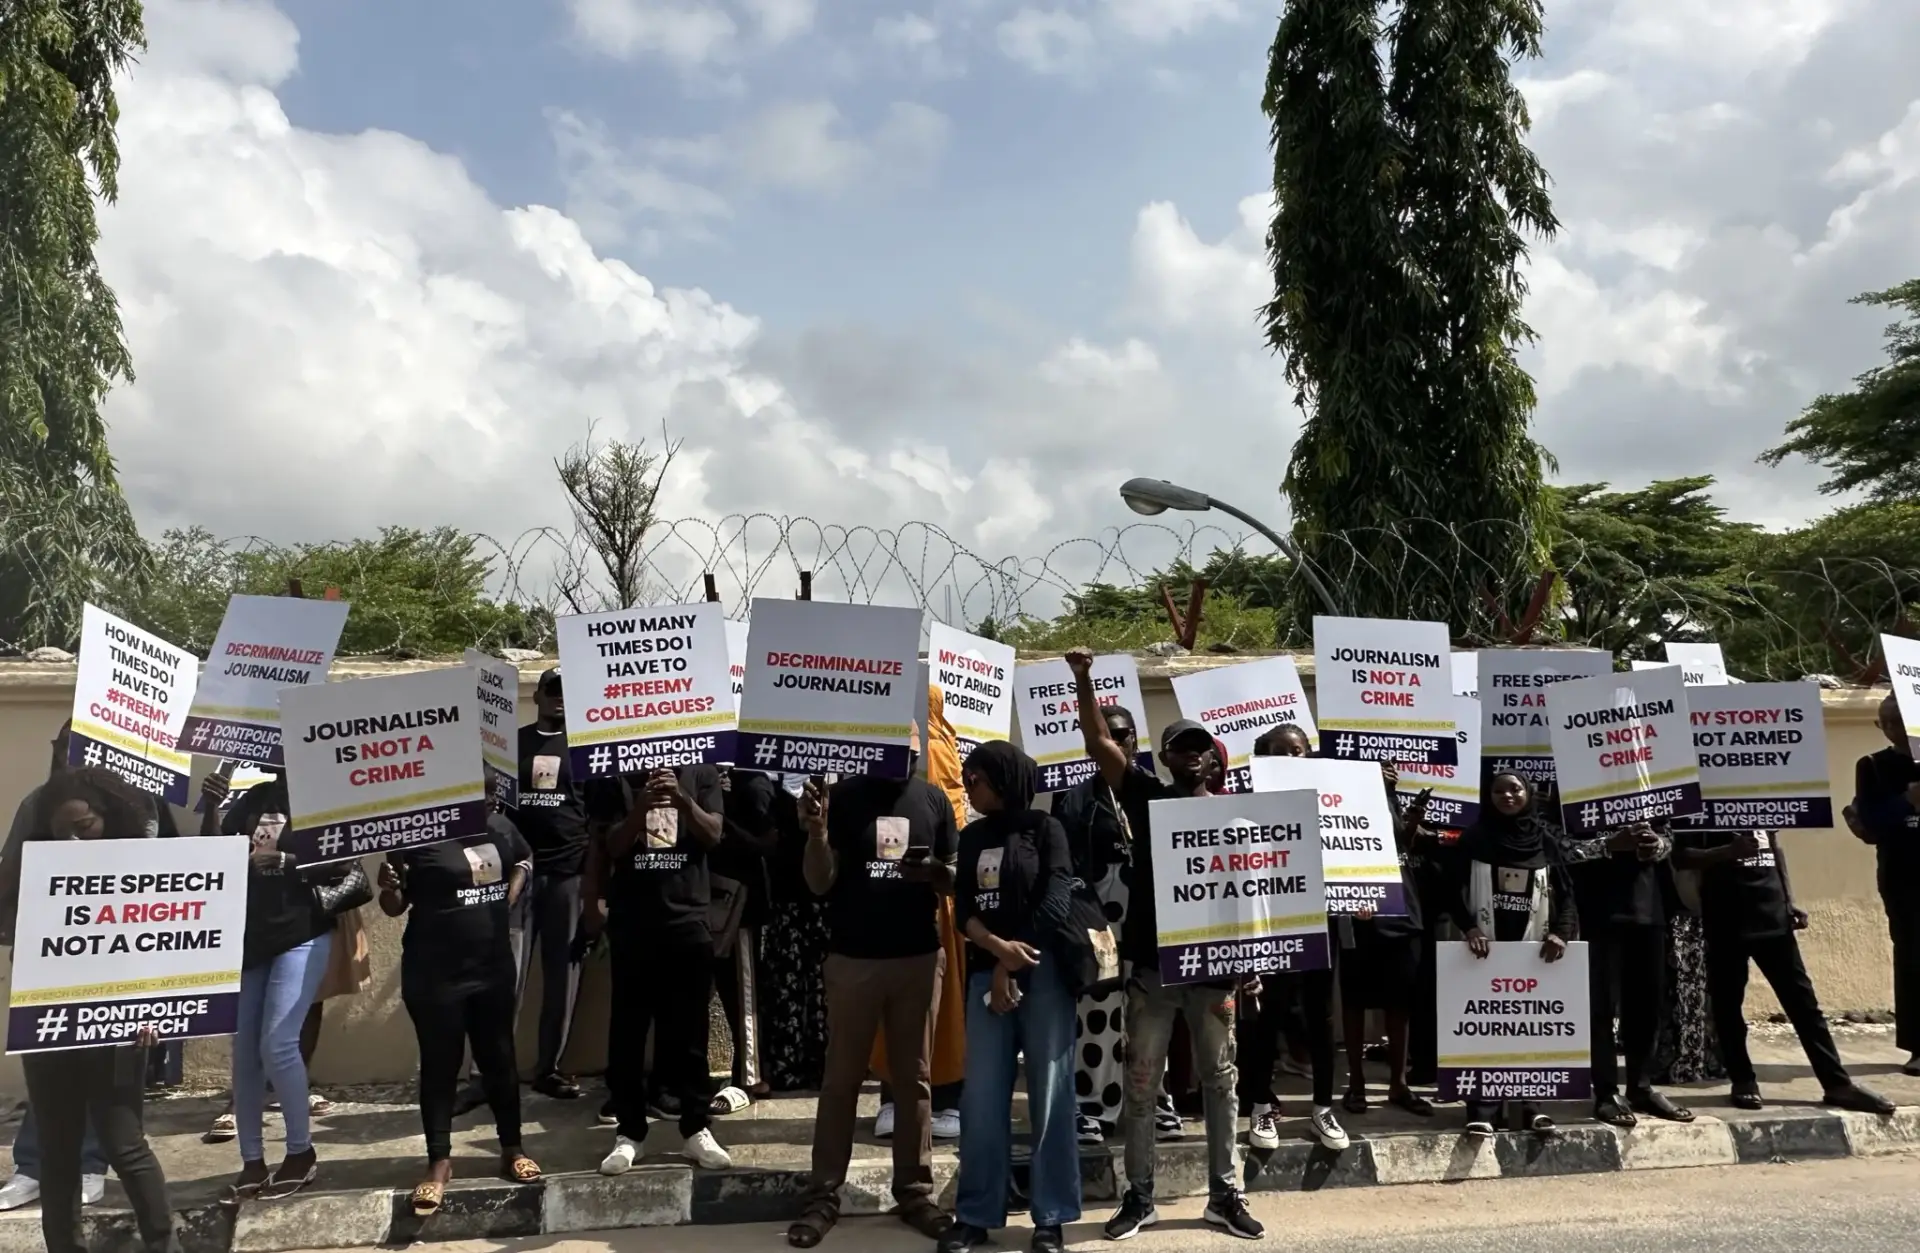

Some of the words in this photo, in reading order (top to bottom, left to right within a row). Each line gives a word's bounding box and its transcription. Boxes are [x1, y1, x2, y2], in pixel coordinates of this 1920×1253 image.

[588, 619, 636, 637] HOW
[640, 614, 697, 633] MANY
[105, 623, 140, 648] HOW
[142, 640, 181, 669] MANY
[225, 642, 325, 665] DECRIMINALIZE
[597, 638, 653, 657] TIMES
[656, 637, 684, 652] DO
[687, 636, 692, 649] I
[110, 645, 147, 674] TIMES
[151, 666, 169, 684] DO
[170, 674, 174, 687] I
[607, 661, 659, 678] HAVE
[661, 657, 687, 674] TO
[766, 651, 903, 676] DECRIMINALIZE
[939, 649, 956, 665] MY
[958, 656, 993, 677] STORY
[994, 666, 1004, 681] IS
[1331, 648, 1440, 668] JOURNALISM
[224, 662, 311, 684] JOURNALISM
[939, 669, 963, 688] NOT
[964, 677, 1001, 698] ARMED
[1352, 669, 1367, 683] IS
[1370, 671, 1406, 686] NOT
[1408, 673, 1421, 687] A
[1493, 675, 1530, 688] FREE
[1684, 673, 1704, 684] ANY
[113, 669, 148, 695] HAVE
[151, 686, 168, 704] TO
[604, 678, 693, 700] #FREEMY
[773, 674, 891, 696] JOURNALISM
[1029, 683, 1066, 699] FREE
[1068, 676, 1125, 694] SECH
[107, 688, 170, 726] #FREEMY
[477, 686, 514, 714] DNAPPERS
[586, 696, 715, 723] COLLEAGUES?
[945, 691, 994, 716] ROBBERY
[1042, 703, 1057, 716] IS
[1060, 701, 1072, 714] A
[1200, 693, 1298, 722] DECRIMINALIZE
[1361, 690, 1415, 707] CRIME
[1504, 694, 1518, 706] IS
[1521, 694, 1533, 706] A
[303, 706, 460, 743] JOURNALISM
[1213, 709, 1296, 736] JOURNALISM
[1492, 713, 1527, 726] NOT
[1529, 713, 1543, 726] A
[1564, 699, 1674, 730] JOURNALISM
[1716, 709, 1781, 724] STORY
[1785, 708, 1804, 723] IS
[1035, 720, 1068, 737] NOT
[1588, 733, 1604, 748] IS
[1606, 728, 1642, 745] NOT
[1644, 724, 1658, 739] A
[1730, 729, 1803, 746] ARMED
[208, 738, 272, 759] MYSPEECH
[336, 746, 358, 764] IS
[361, 737, 412, 760] NOT
[417, 734, 434, 753] A
[618, 736, 715, 758] DONTPOLICE
[784, 740, 884, 761] DONTPOLICE
[1359, 736, 1439, 751] DONTPOLICE
[619, 752, 703, 773] MYSPEECH
[782, 755, 868, 775] MYSPEECH
[1359, 748, 1428, 763] MYSPEECH
[1599, 746, 1653, 768] CRIME
[1700, 751, 1791, 768] ROBBERY
[106, 749, 175, 786] DONTPOLICE
[350, 760, 425, 786] CRIME
[1396, 763, 1455, 778] INIONS
[105, 763, 164, 796] YSPEECH
[1603, 789, 1683, 813] DONTPOLICE
[1714, 801, 1809, 814] DONTPOLICE
[350, 808, 460, 838] DONTPOLICE
[1319, 815, 1369, 830] STING
[1605, 803, 1674, 826] MYSPEECH
[1715, 814, 1796, 826] MYSPEECH
[352, 824, 446, 852] MYSPEECH
[1172, 829, 1220, 849] FREE
[1223, 823, 1302, 845] SPEECH
[1320, 836, 1382, 851] NALISTS
[1186, 858, 1206, 875] IS
[1209, 856, 1225, 873] A
[1228, 850, 1291, 871] RIGHT
[49, 875, 116, 896] FREE
[120, 872, 224, 894] SPEECH
[1173, 882, 1218, 903] NOT
[1223, 881, 1239, 899] A
[1242, 875, 1307, 897] CRIME
[1324, 886, 1386, 899] NTPOLICE
[65, 906, 91, 926] IS
[95, 904, 116, 925] A
[122, 901, 206, 923] RIGHT
[41, 936, 105, 957] NOT
[108, 934, 130, 954] A
[135, 929, 222, 952] CRIME
[1207, 939, 1304, 960] DONTPOLICE
[1208, 956, 1291, 976] MYSPEECH
[1491, 978, 1538, 993] STOP
[78, 999, 209, 1024] DONTPOLICE
[1464, 1000, 1564, 1015] ARRESTING
[1453, 1022, 1575, 1036] JOURNALISTS
[1482, 1072, 1569, 1083] DONTPOLICE
[1482, 1085, 1557, 1097] MYSPEECH
